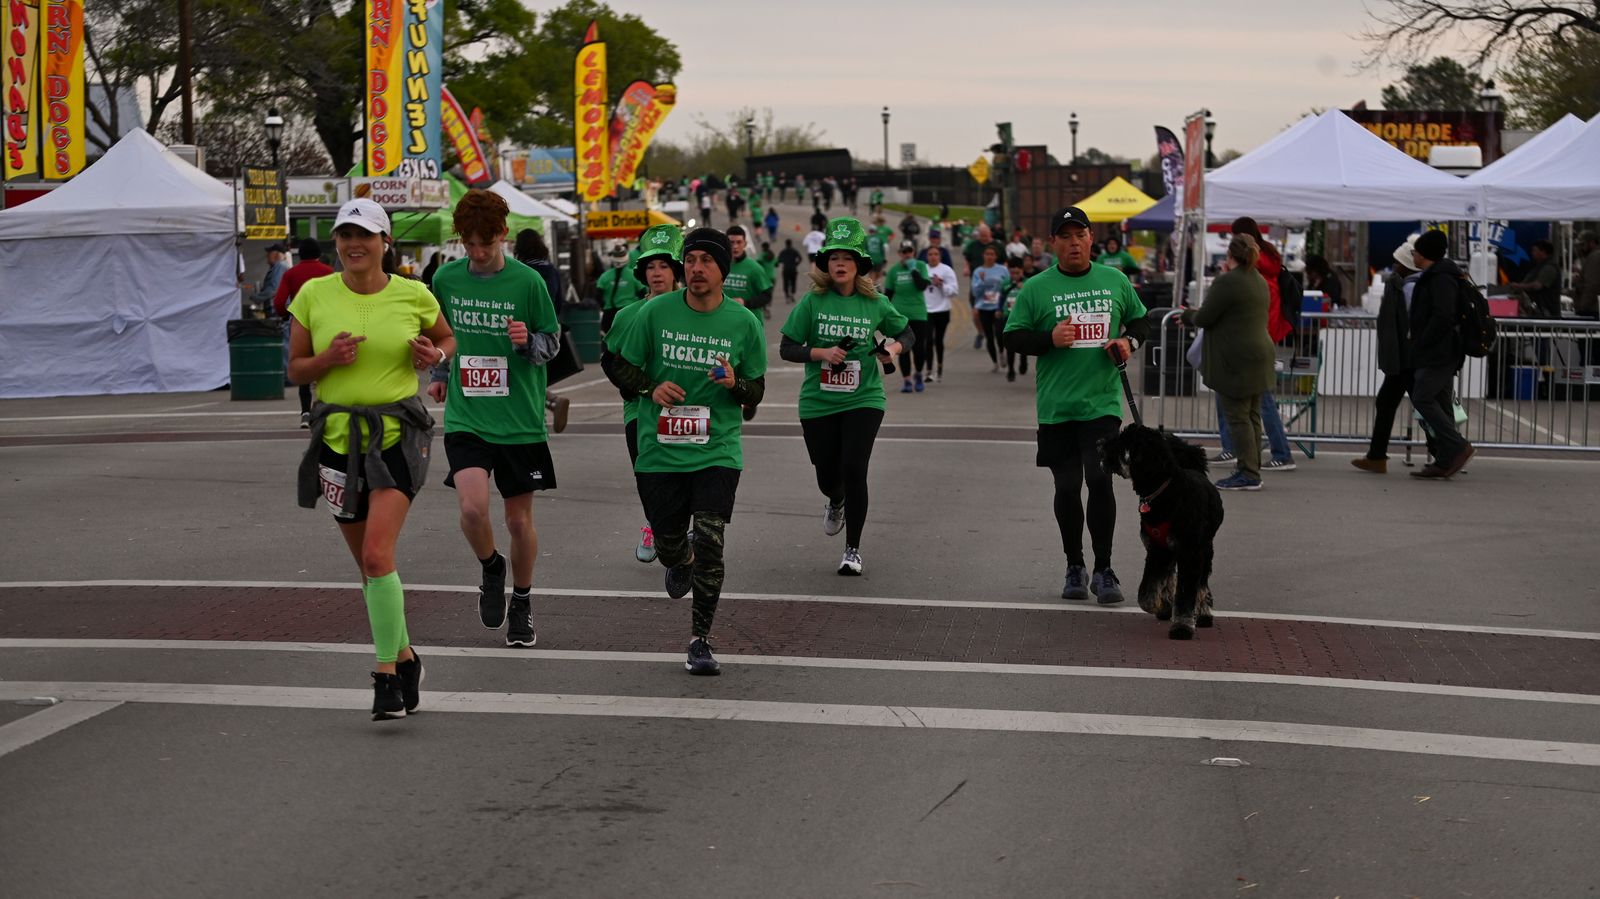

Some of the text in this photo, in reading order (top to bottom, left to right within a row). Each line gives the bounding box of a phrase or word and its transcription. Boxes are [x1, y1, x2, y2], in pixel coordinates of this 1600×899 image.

[48, 75, 72, 175] DOGS
[370, 69, 389, 172] DOGS
[579, 50, 604, 197] LEMONADE
[372, 180, 407, 190] CORN
[372, 194, 407, 204] DOGS
[587, 212, 649, 227] ruit Drinks
[451, 296, 515, 310] I'm just here for the
[1064, 293, 1076, 301] just
[1055, 299, 1113, 318] PICKLES!
[853, 316, 861, 324] for
[662, 329, 732, 347] I'm just here for the
[818, 323, 870, 340] PICKLES!
[1079, 324, 1102, 339] 1113
[466, 370, 499, 386] 1942
[827, 371, 854, 384] 1406
[667, 418, 699, 435] 1401
